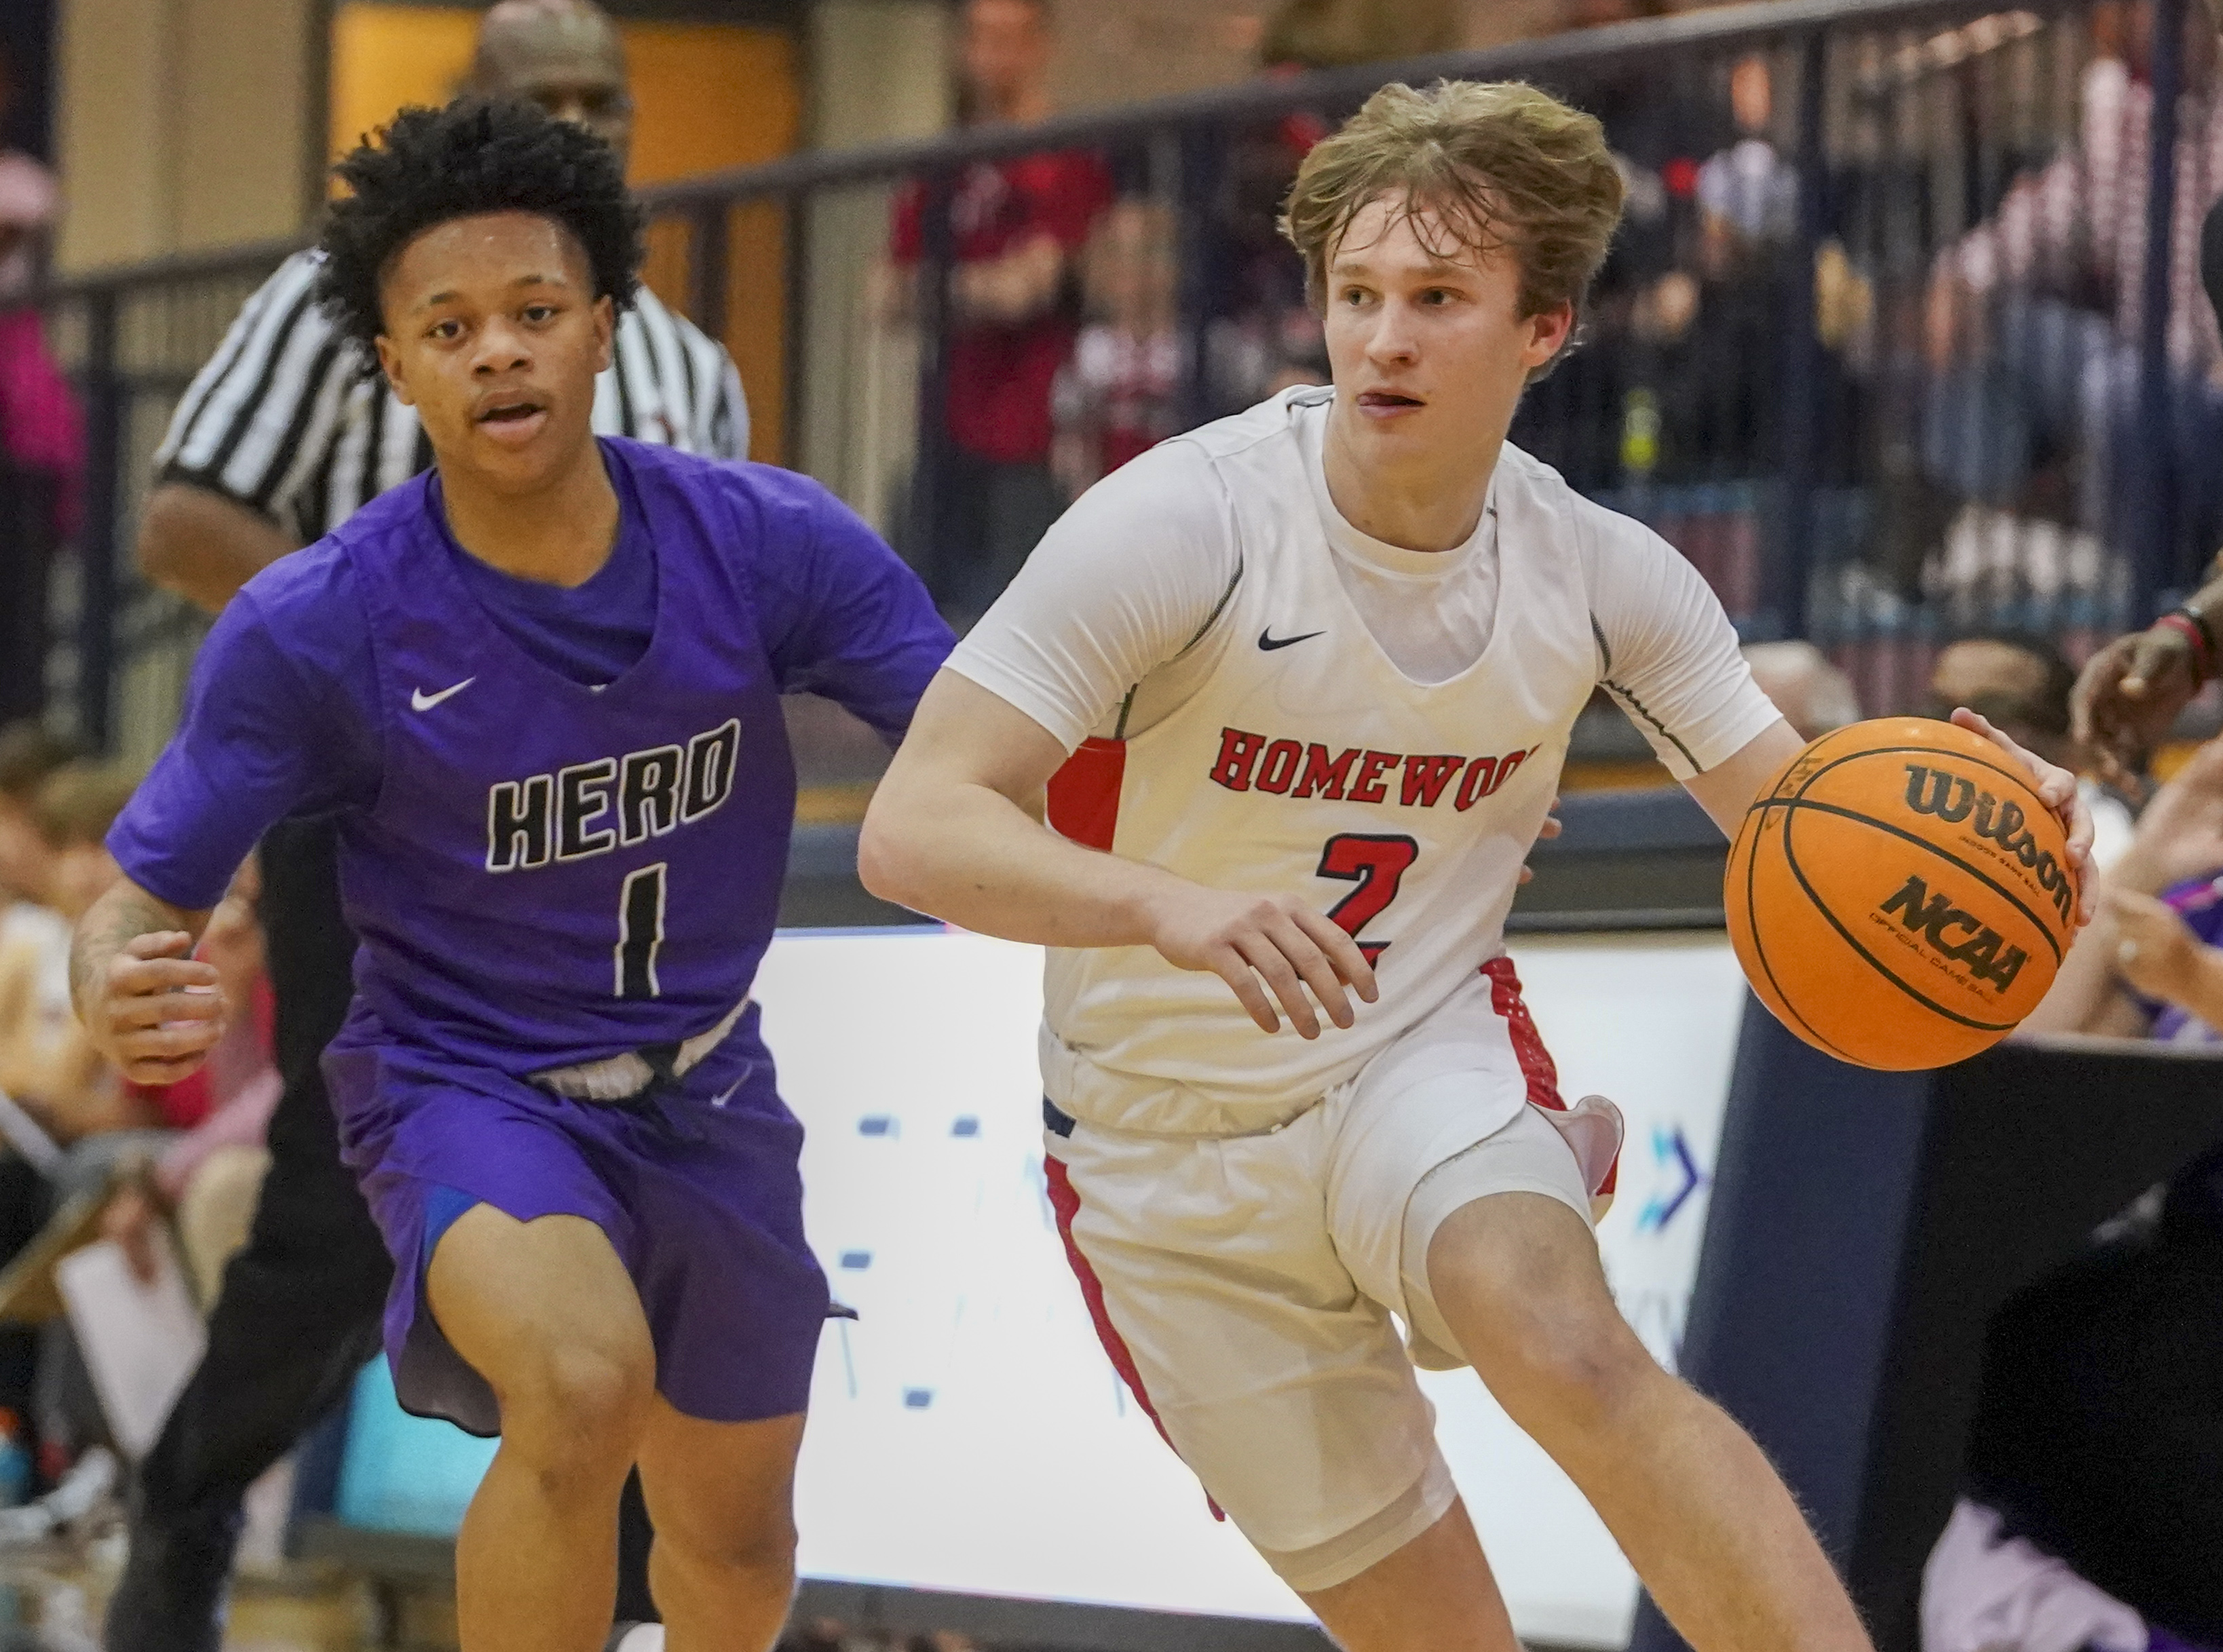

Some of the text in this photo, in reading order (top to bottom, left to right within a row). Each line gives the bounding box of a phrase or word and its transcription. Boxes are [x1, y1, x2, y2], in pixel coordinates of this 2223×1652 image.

[486, 718, 740, 873] HERD
[1210, 727, 1543, 812] HOMEWOO
[1315, 832, 1420, 973] 2
[1904, 764, 2072, 929] Wilson
[613, 862, 667, 997] 1
[1869, 912, 1928, 959] OFFICIAL
[1929, 957, 1969, 985] GAME
[1880, 875, 2028, 995] NCAA
